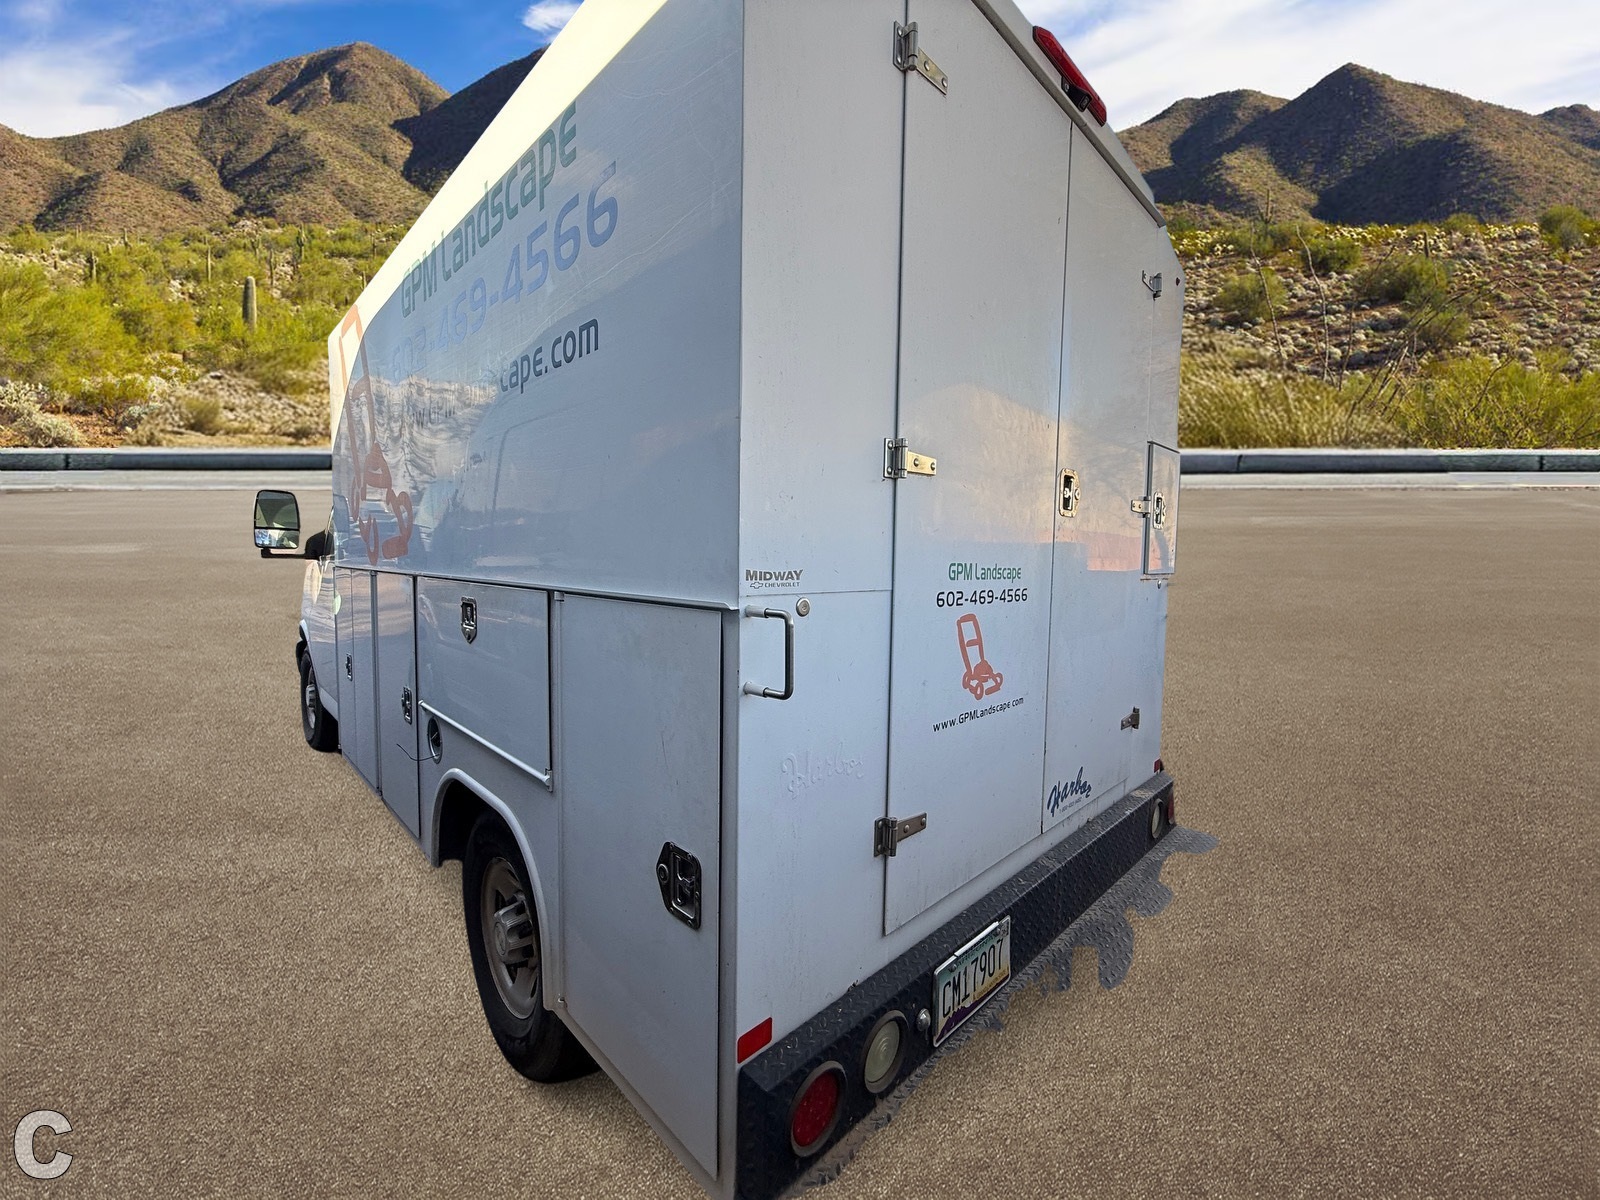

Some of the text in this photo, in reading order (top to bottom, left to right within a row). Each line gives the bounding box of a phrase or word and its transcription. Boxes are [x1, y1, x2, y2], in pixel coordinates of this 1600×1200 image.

[401, 100, 577, 318] GPM Landscape
[745, 569, 803, 581] MIDWAY
[948, 563, 1022, 583] GPM Landscape
[936, 588, 1028, 607] 602-469-4566
[932, 697, 1024, 732] www.GPMLandscapecom
[943, 938, 1004, 1018] CM17907
